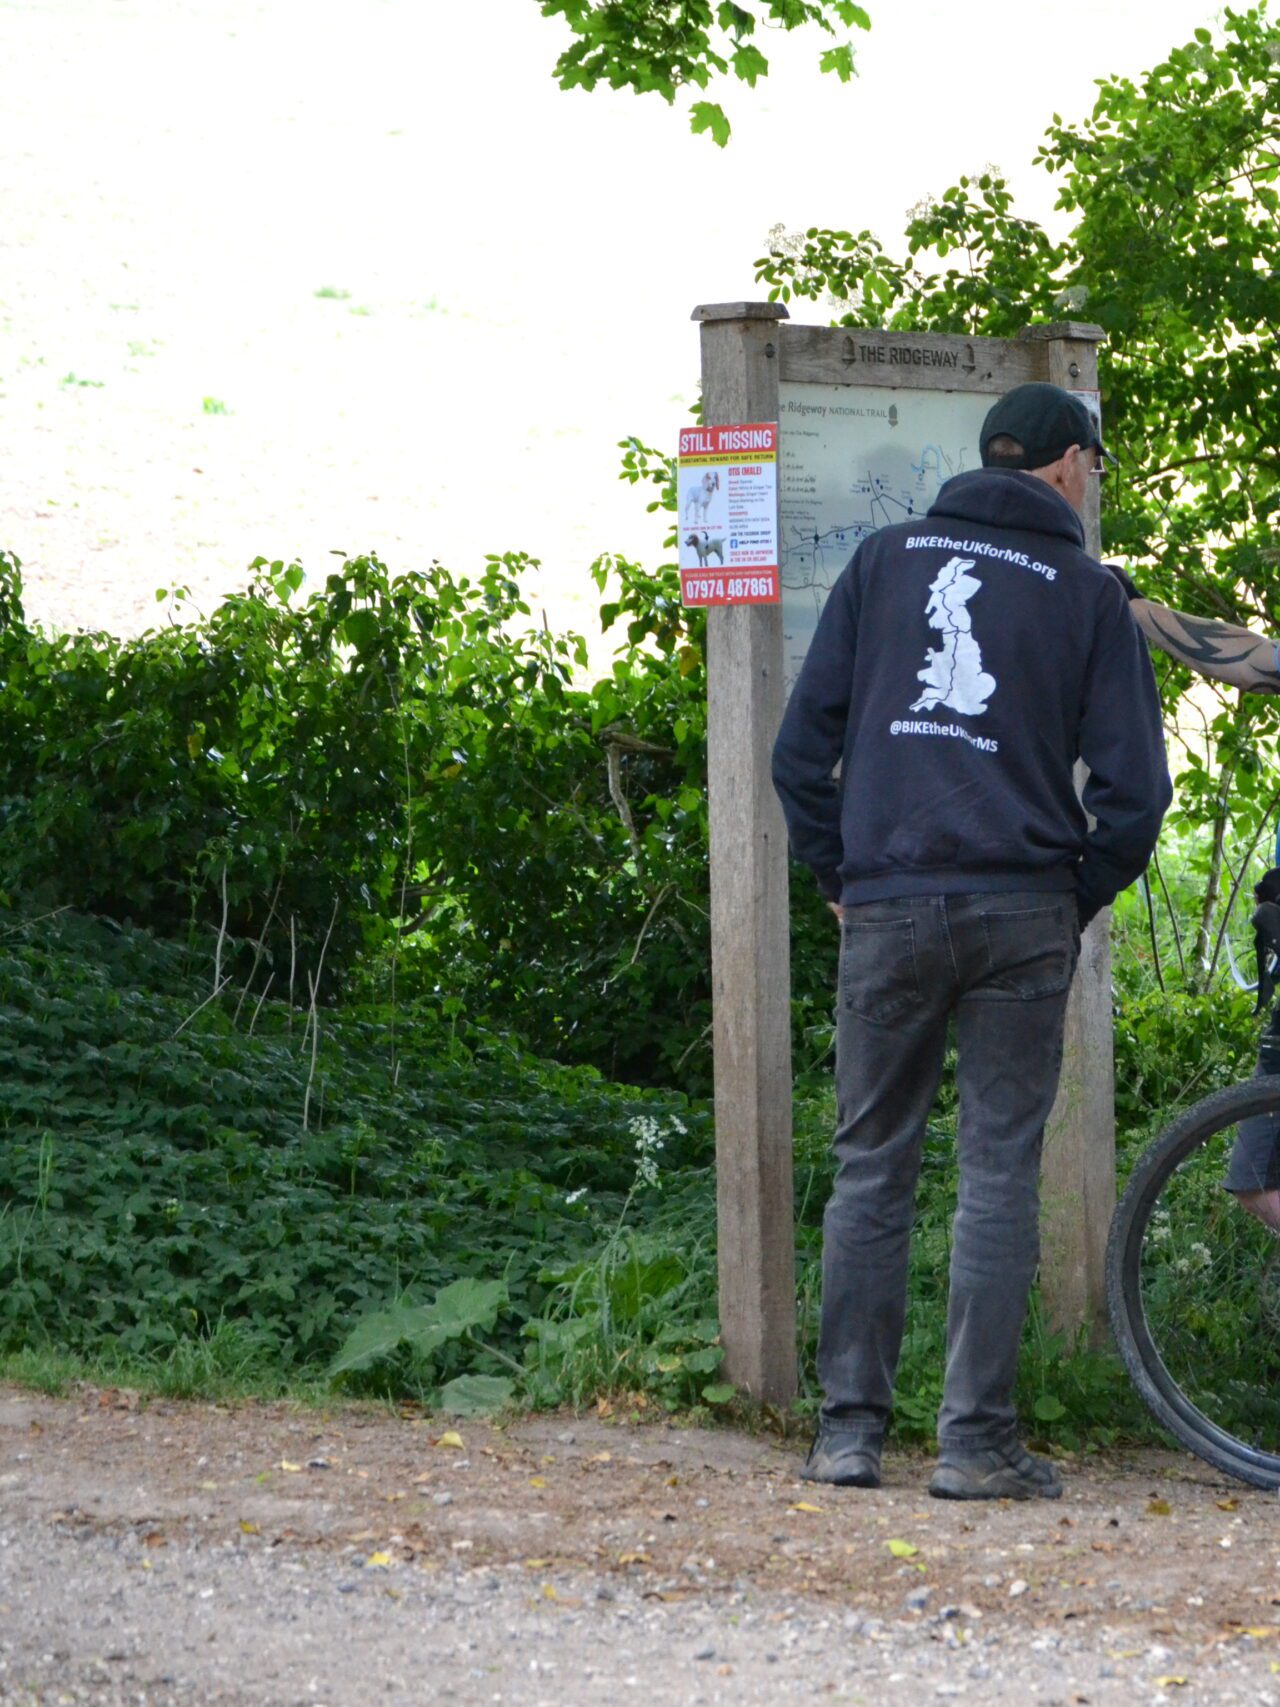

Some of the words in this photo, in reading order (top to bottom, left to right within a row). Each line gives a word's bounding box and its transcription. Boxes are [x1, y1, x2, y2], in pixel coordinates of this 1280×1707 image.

[859, 345, 885, 363] THE
[889, 347, 959, 368] RIDGEWAY
[788, 401, 828, 417] Ridgeway
[829, 407, 865, 417] NATIONAL
[867, 408, 888, 419] TRAIL
[681, 433, 714, 453] STILL
[719, 429, 772, 450] MISSING
[905, 535, 1058, 581] BIKEtheUKforMS.org
[686, 579, 725, 599] 07974
[727, 577, 774, 597] 487861
